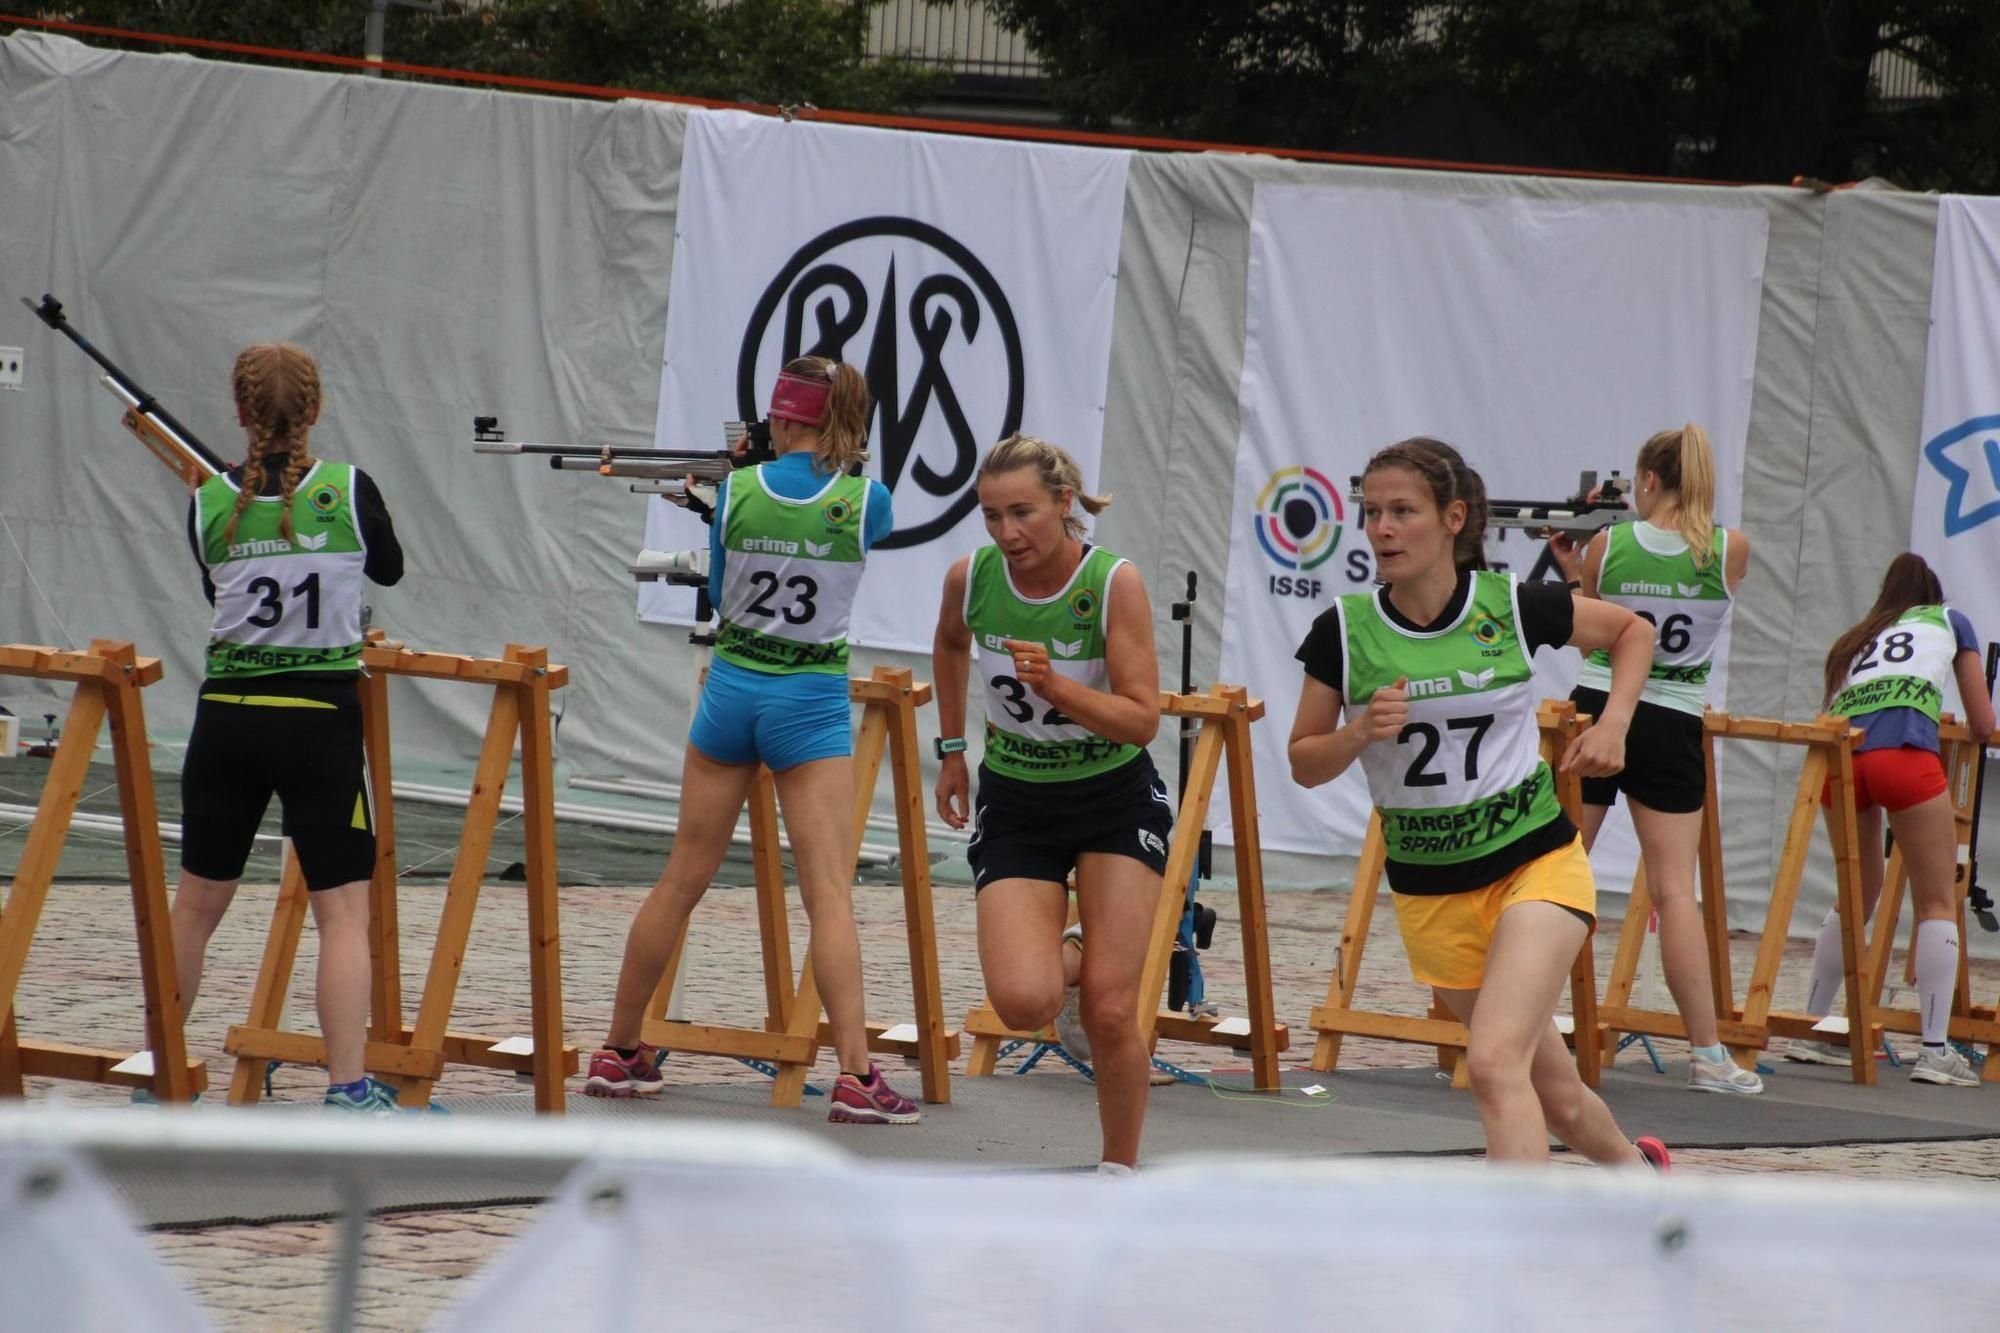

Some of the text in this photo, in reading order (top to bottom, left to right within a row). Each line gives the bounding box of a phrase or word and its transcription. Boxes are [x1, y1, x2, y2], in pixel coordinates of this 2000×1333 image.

[229, 538, 292, 557] erima
[742, 536, 799, 555] erima
[246, 572, 320, 629] 31
[745, 570, 818, 625] 23
[1269, 574, 1321, 600] ISSF
[1620, 580, 1673, 596] erima
[1634, 610, 1693, 654] 6
[1852, 632, 1914, 676] 28
[1002, 736, 1072, 760] TARGET
[1397, 713, 1495, 787] 27
[1397, 805, 1480, 833] TARGET
[1401, 827, 1482, 854] SPRINT
